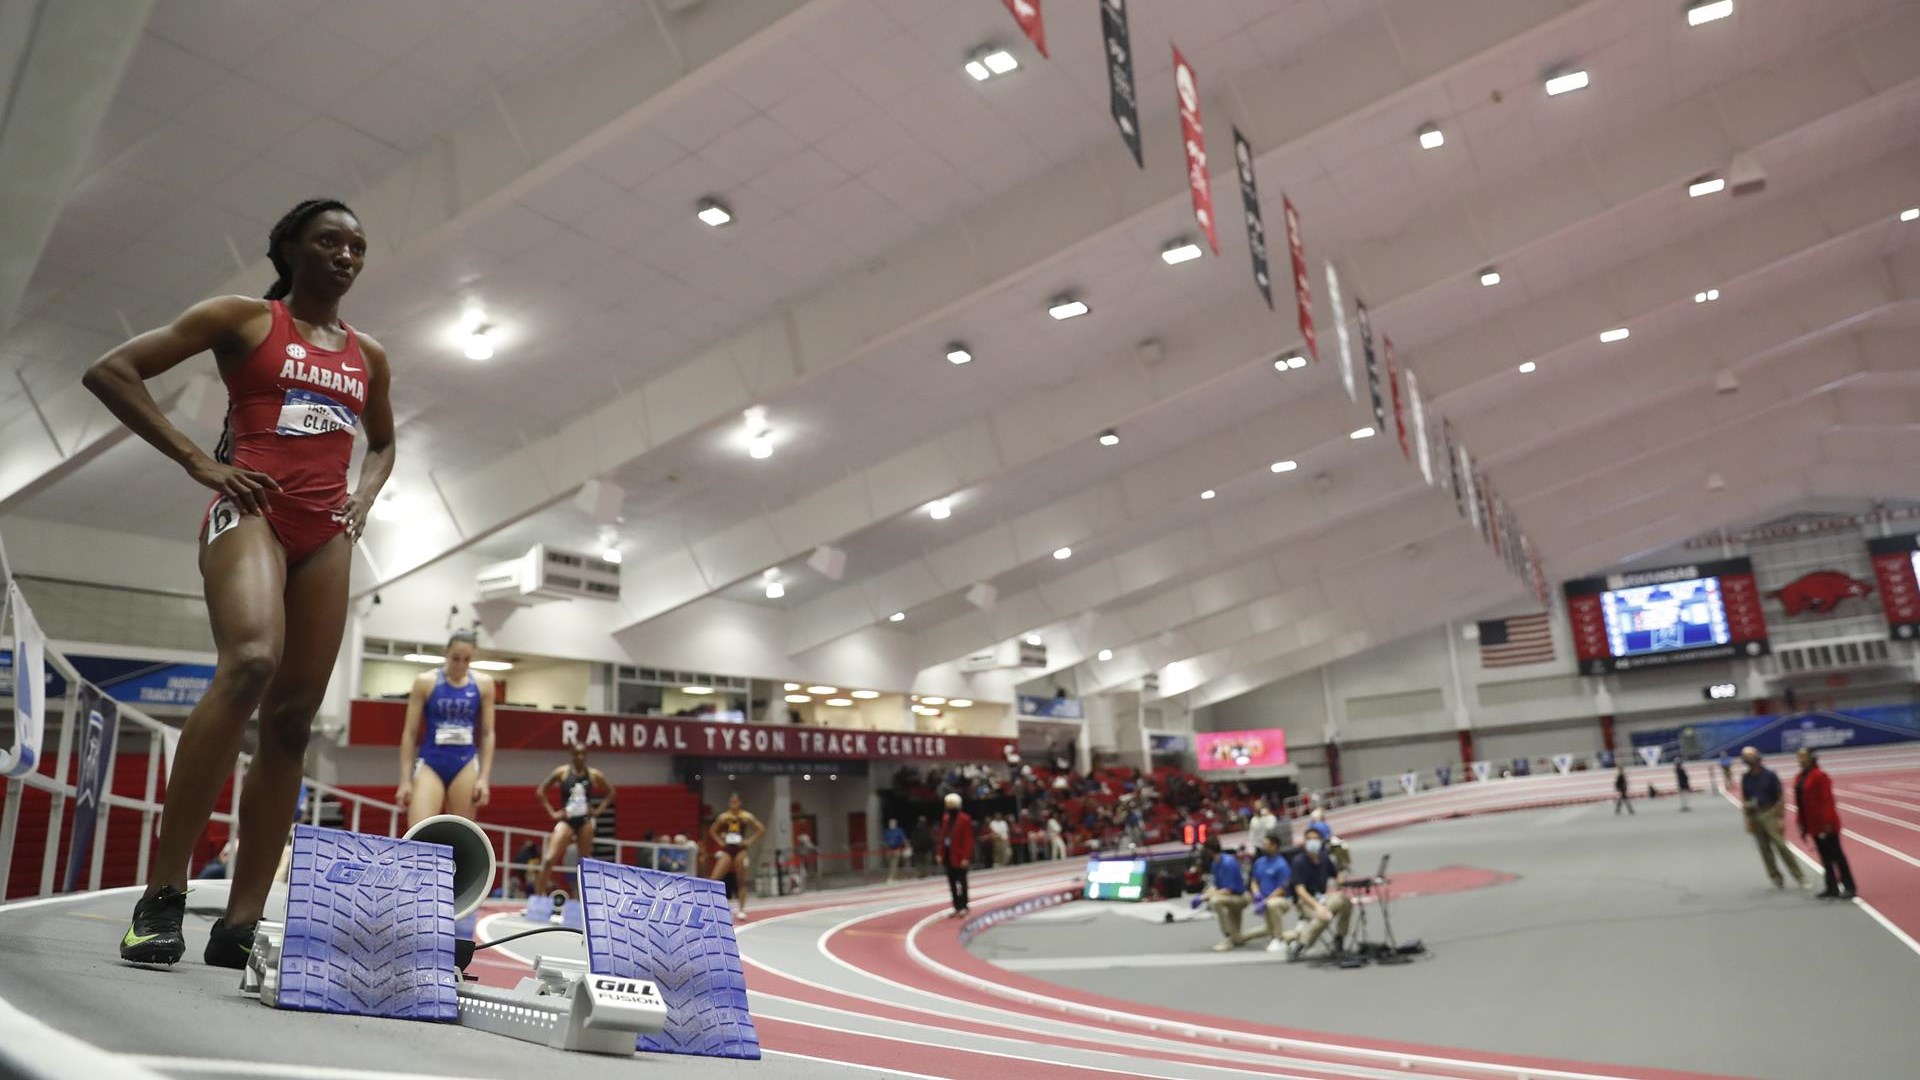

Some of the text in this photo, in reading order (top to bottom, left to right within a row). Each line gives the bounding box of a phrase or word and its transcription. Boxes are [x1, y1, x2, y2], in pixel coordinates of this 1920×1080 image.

[279, 359, 365, 402] ALABAMA
[562, 720, 946, 756] RANDAL TYSON TRACK CENTER
[617, 898, 707, 929] GILL
[595, 979, 654, 996] GILL
[598, 993, 660, 1006] FUSION
